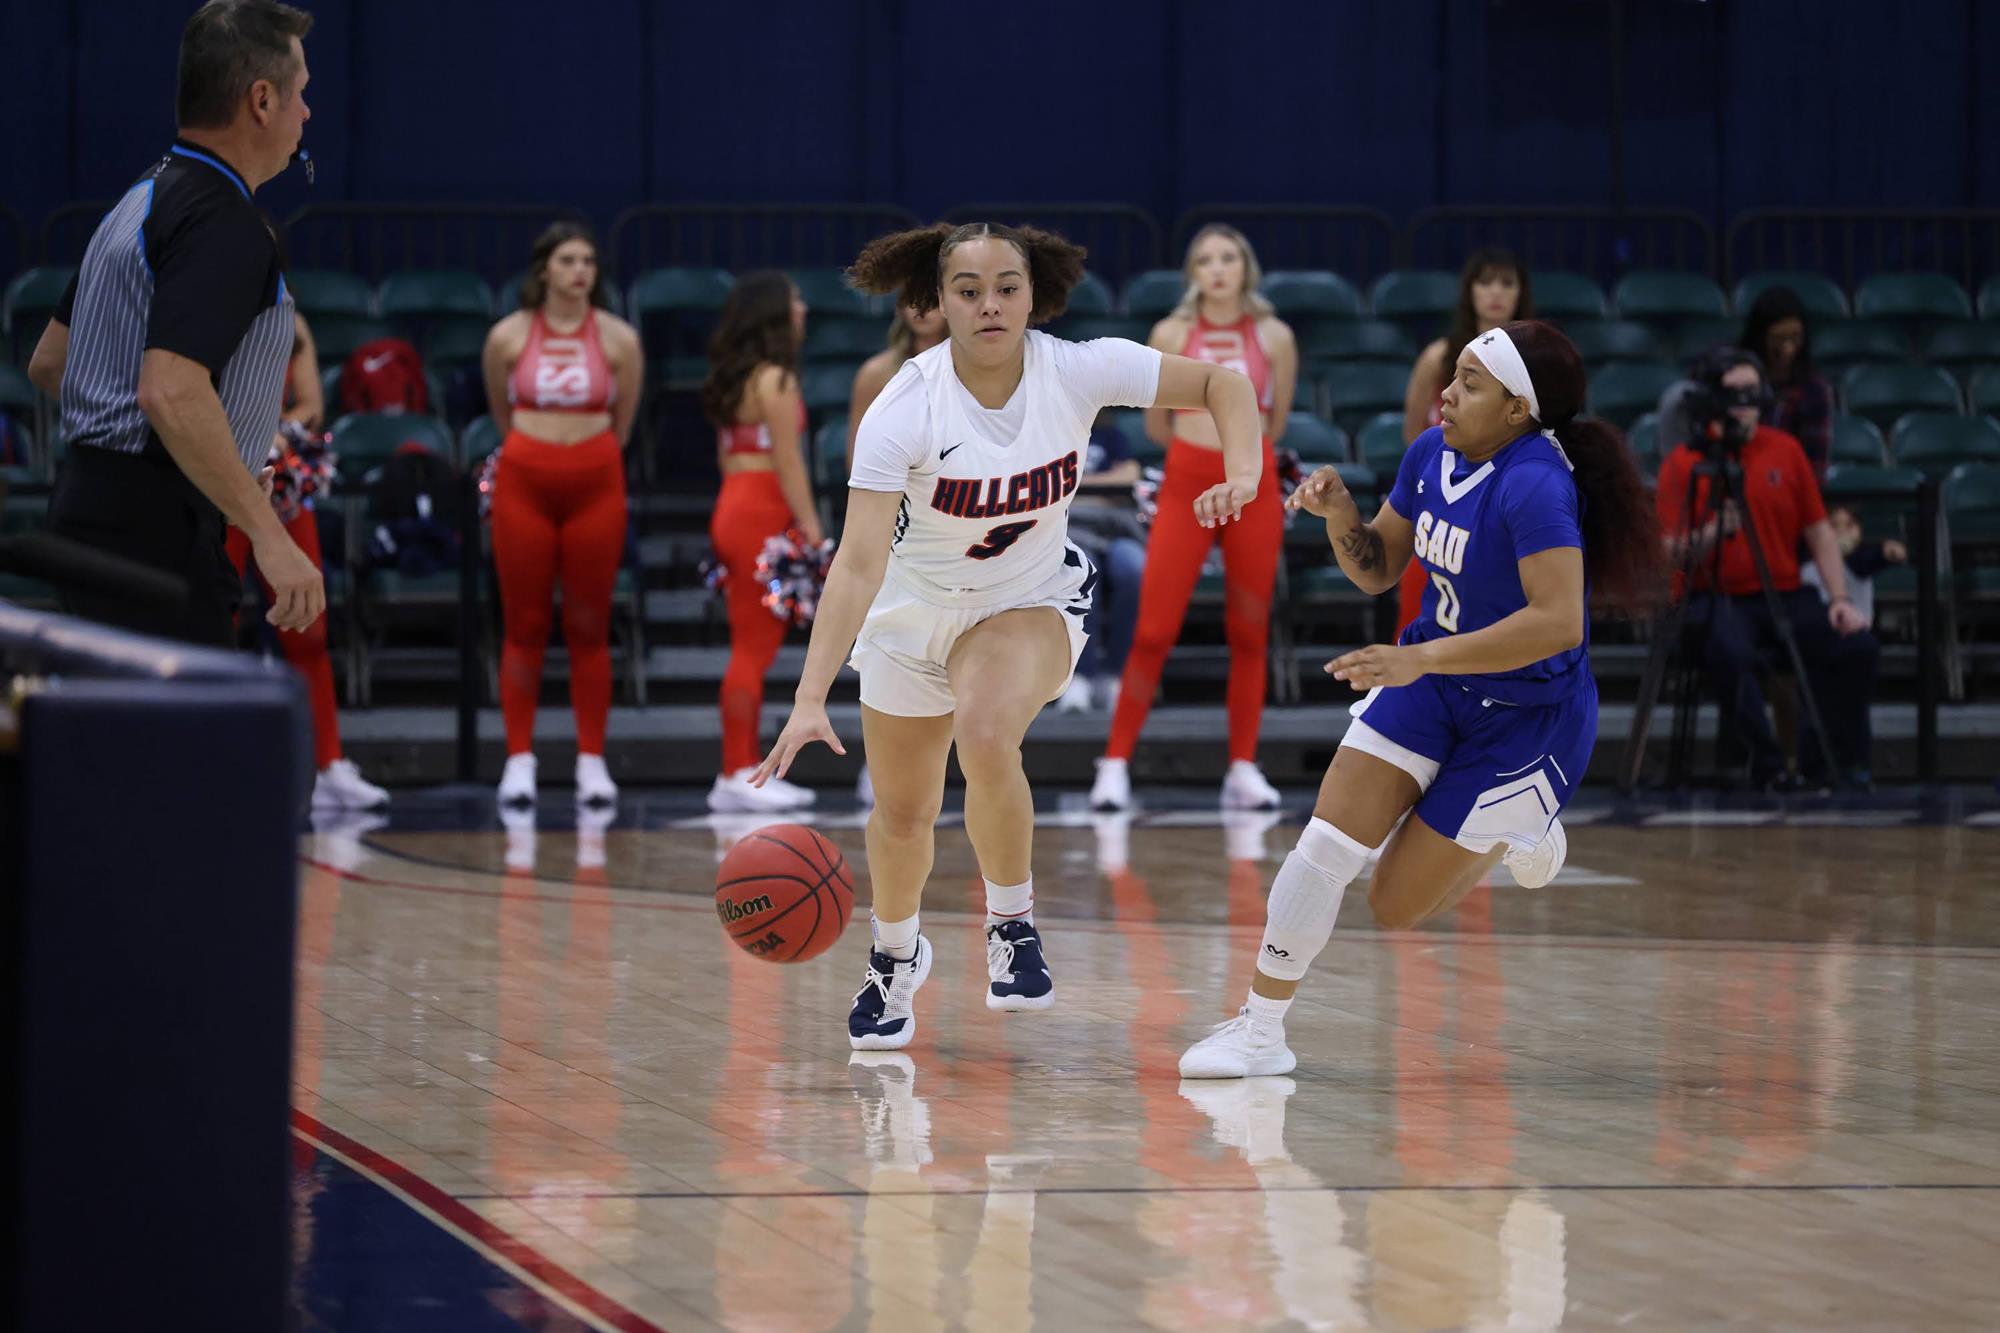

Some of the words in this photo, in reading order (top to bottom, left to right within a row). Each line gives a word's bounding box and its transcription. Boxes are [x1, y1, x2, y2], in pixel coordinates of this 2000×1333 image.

[930, 450, 1078, 519] HILLCATS
[1414, 510, 1471, 576] SAU
[1430, 571, 1461, 634] 0
